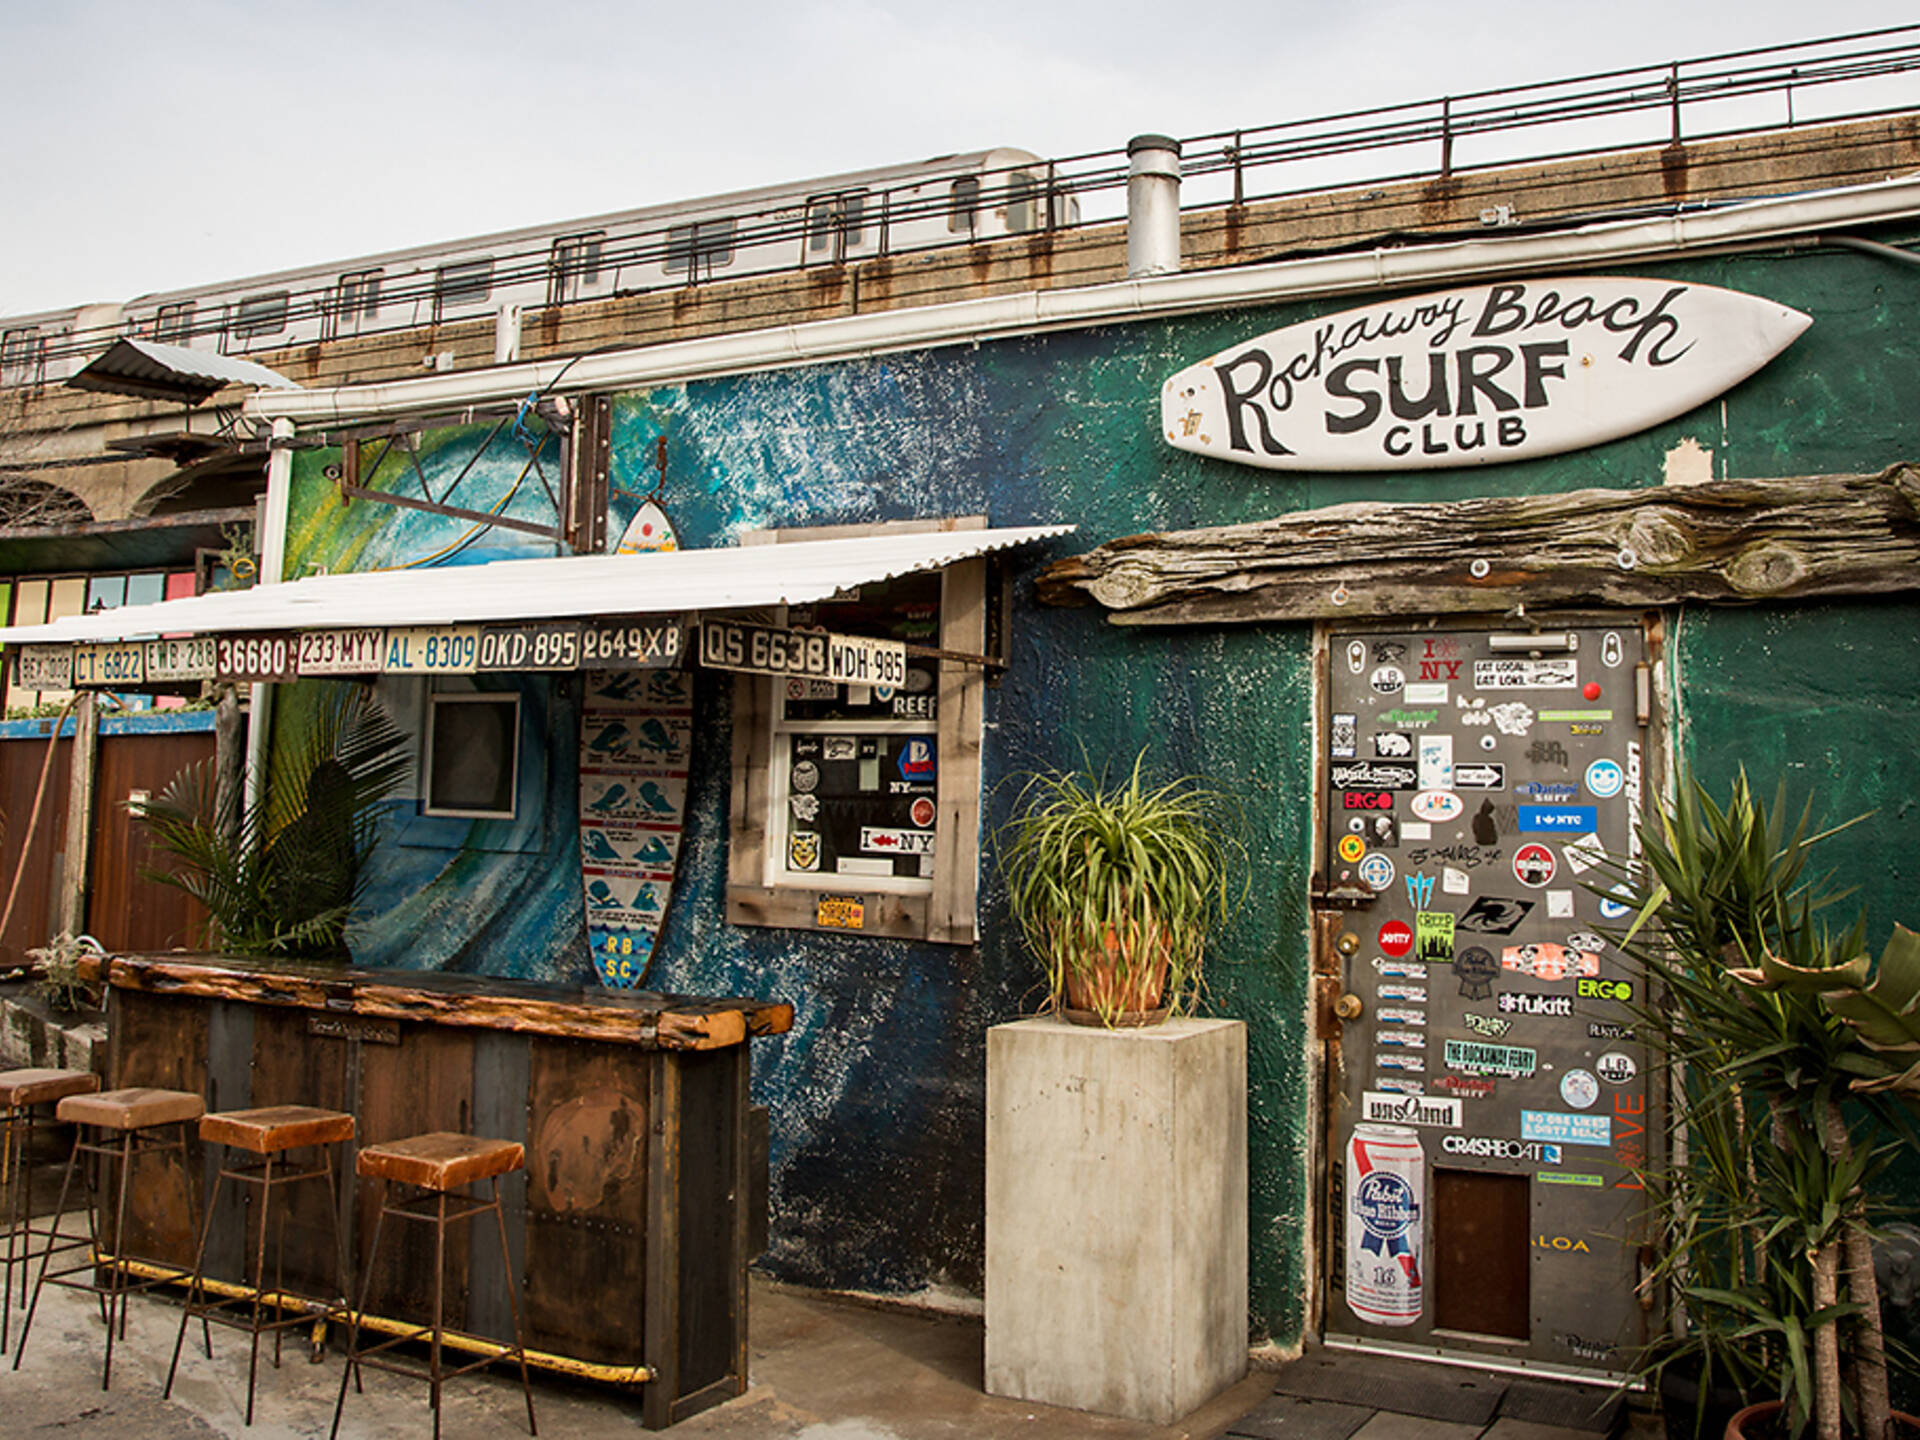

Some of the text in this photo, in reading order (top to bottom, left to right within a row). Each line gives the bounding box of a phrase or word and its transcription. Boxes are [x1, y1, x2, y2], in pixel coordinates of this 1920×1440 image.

[1213, 284, 1699, 456] Rockaway Beach
[1323, 339, 1569, 435] SURF
[1381, 417, 1528, 456] CLUB
[219, 638, 287, 675] 36680
[707, 624, 826, 673] QS 6638
[1423, 639, 1435, 658] I
[1419, 660, 1463, 680] NY
[1344, 792, 1393, 809] ERGO
[863, 830, 934, 852] I NY
[1577, 979, 1632, 1000] ERGO
[1531, 1235, 1590, 1253] LOA
